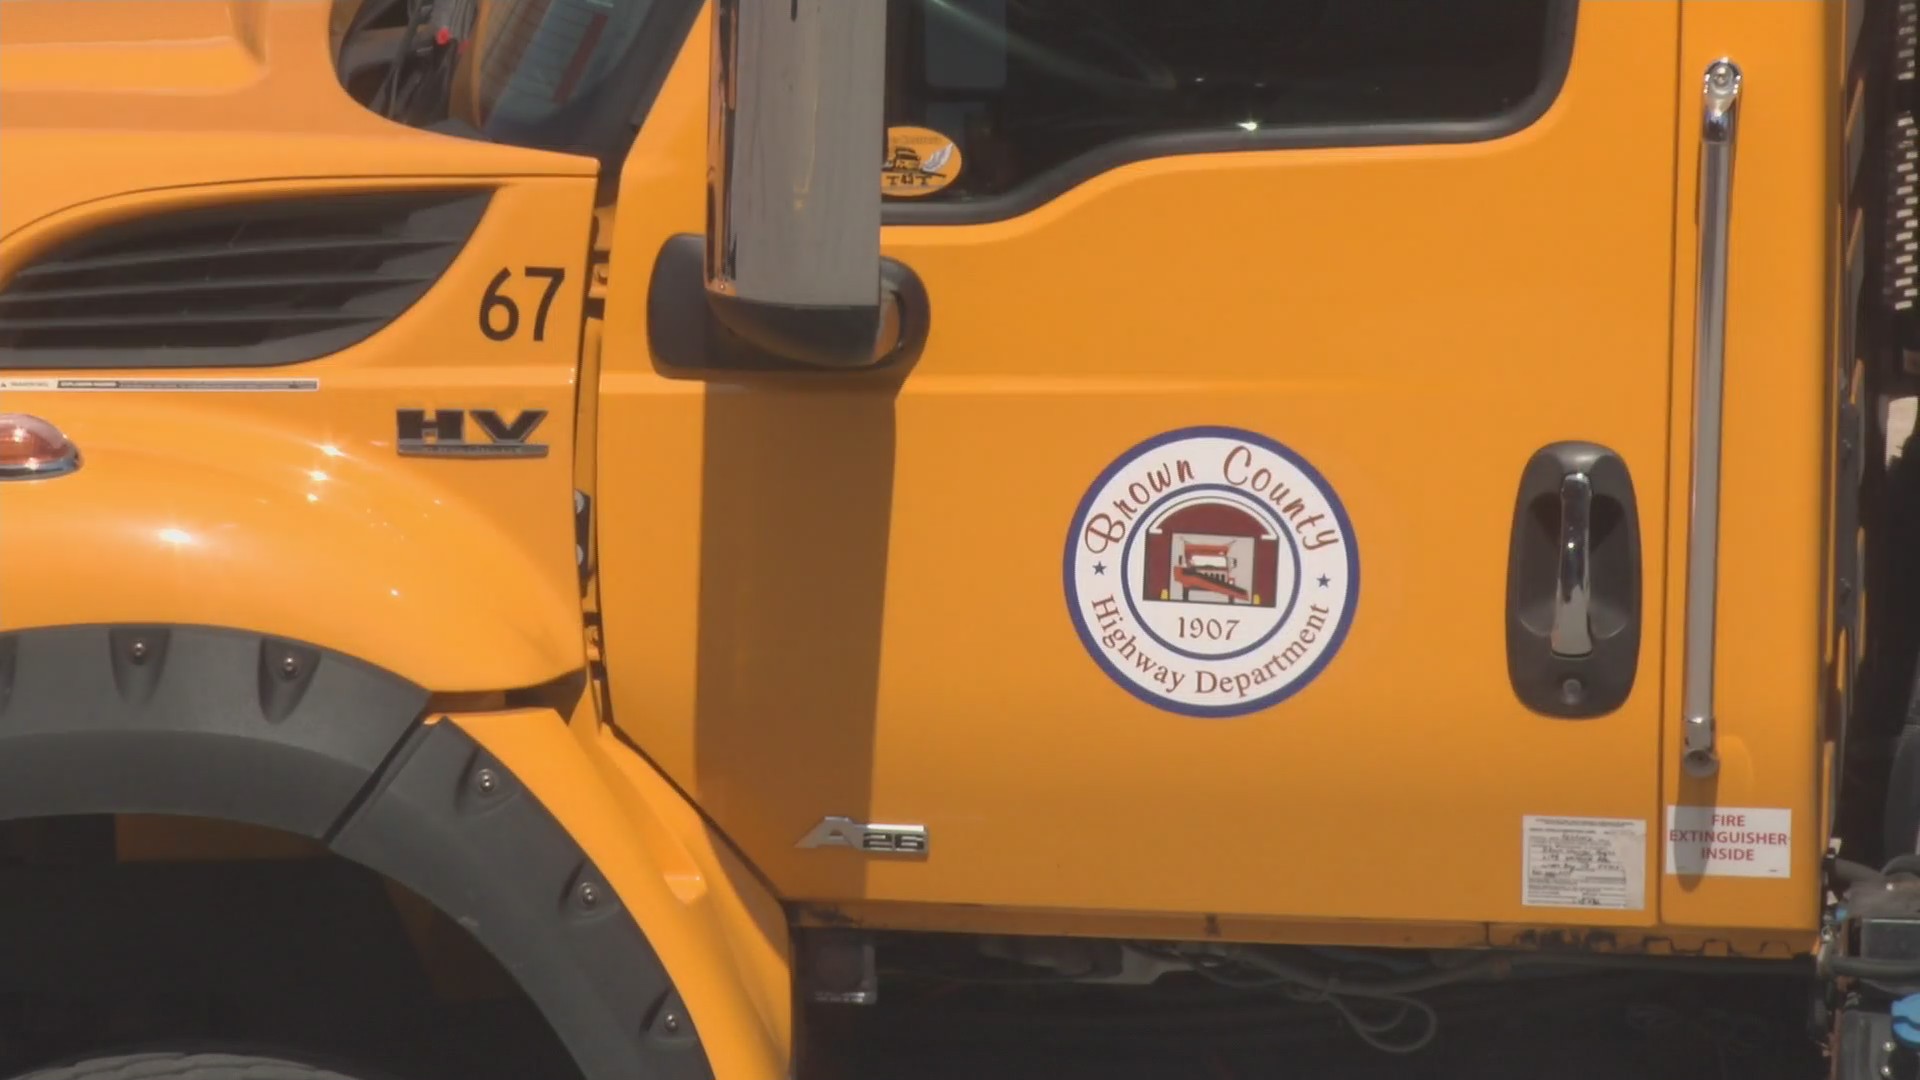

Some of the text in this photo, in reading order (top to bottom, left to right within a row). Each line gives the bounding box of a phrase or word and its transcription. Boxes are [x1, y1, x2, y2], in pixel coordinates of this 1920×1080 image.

[478, 266, 566, 342] 67
[396, 409, 549, 445] HV
[1084, 444, 1340, 555] Brown County
[1177, 615, 1241, 641] 1907
[1091, 593, 1331, 697] Highway Department
[1711, 814, 1746, 827] FIRE
[1669, 830, 1788, 846] EXTINGUISHER
[1701, 847, 1756, 862] INSIDE
